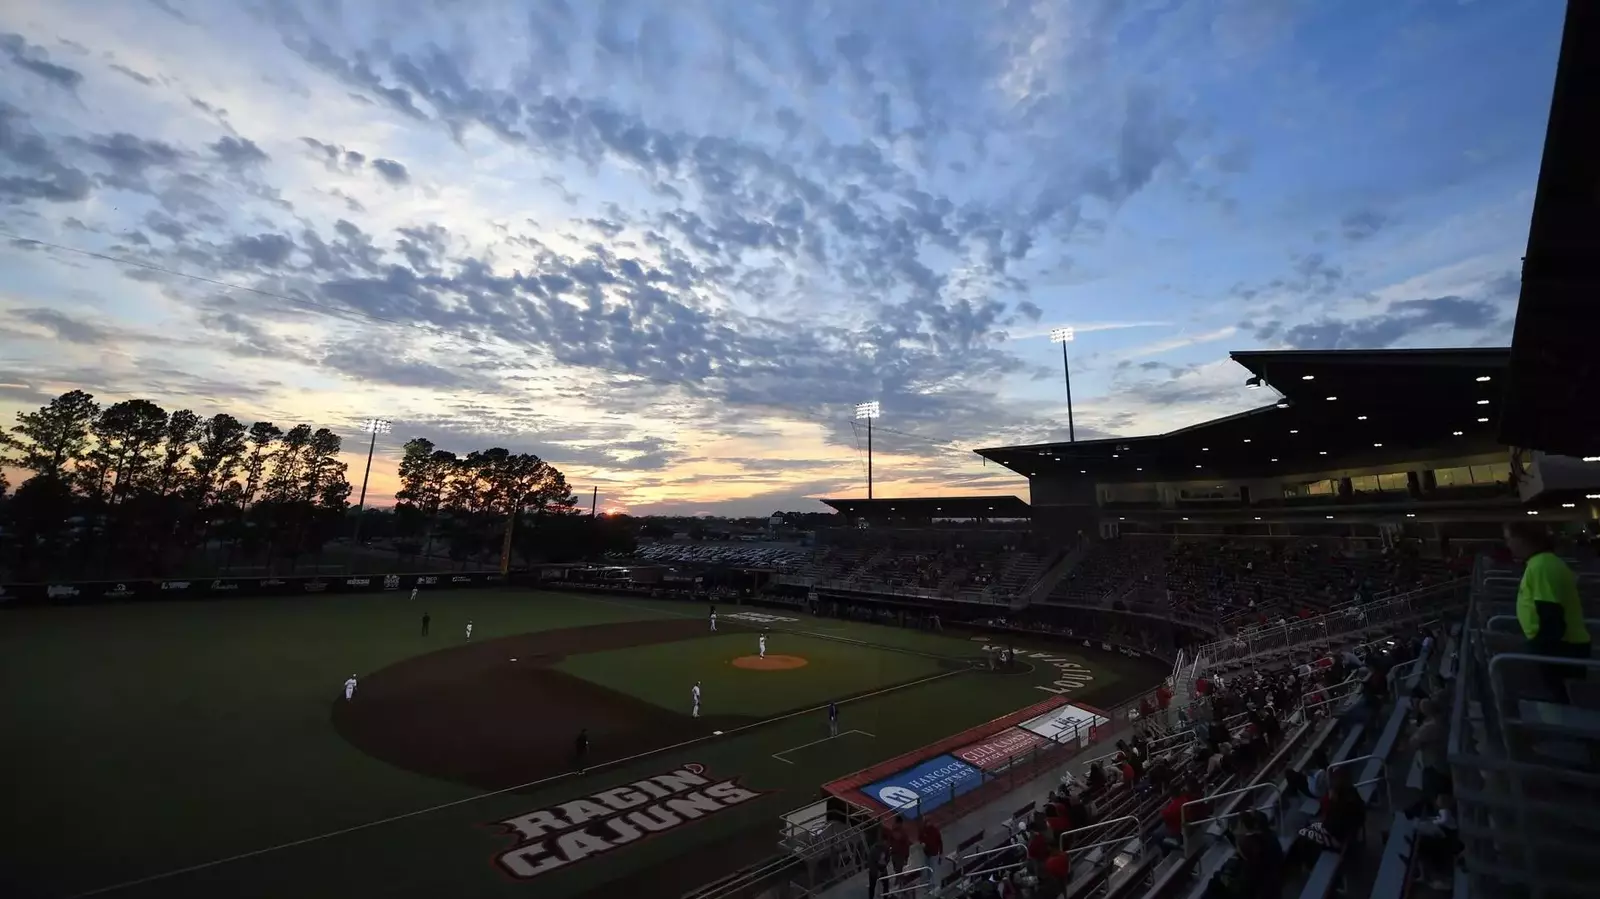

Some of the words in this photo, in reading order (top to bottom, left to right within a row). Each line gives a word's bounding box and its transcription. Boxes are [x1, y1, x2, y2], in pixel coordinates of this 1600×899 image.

[962, 743, 996, 761] GULF
[993, 730, 1031, 749] COAST
[976, 751, 1004, 766] OFFICE
[908, 761, 965, 789] HANCOCK
[499, 780, 763, 877] CAJUNS
